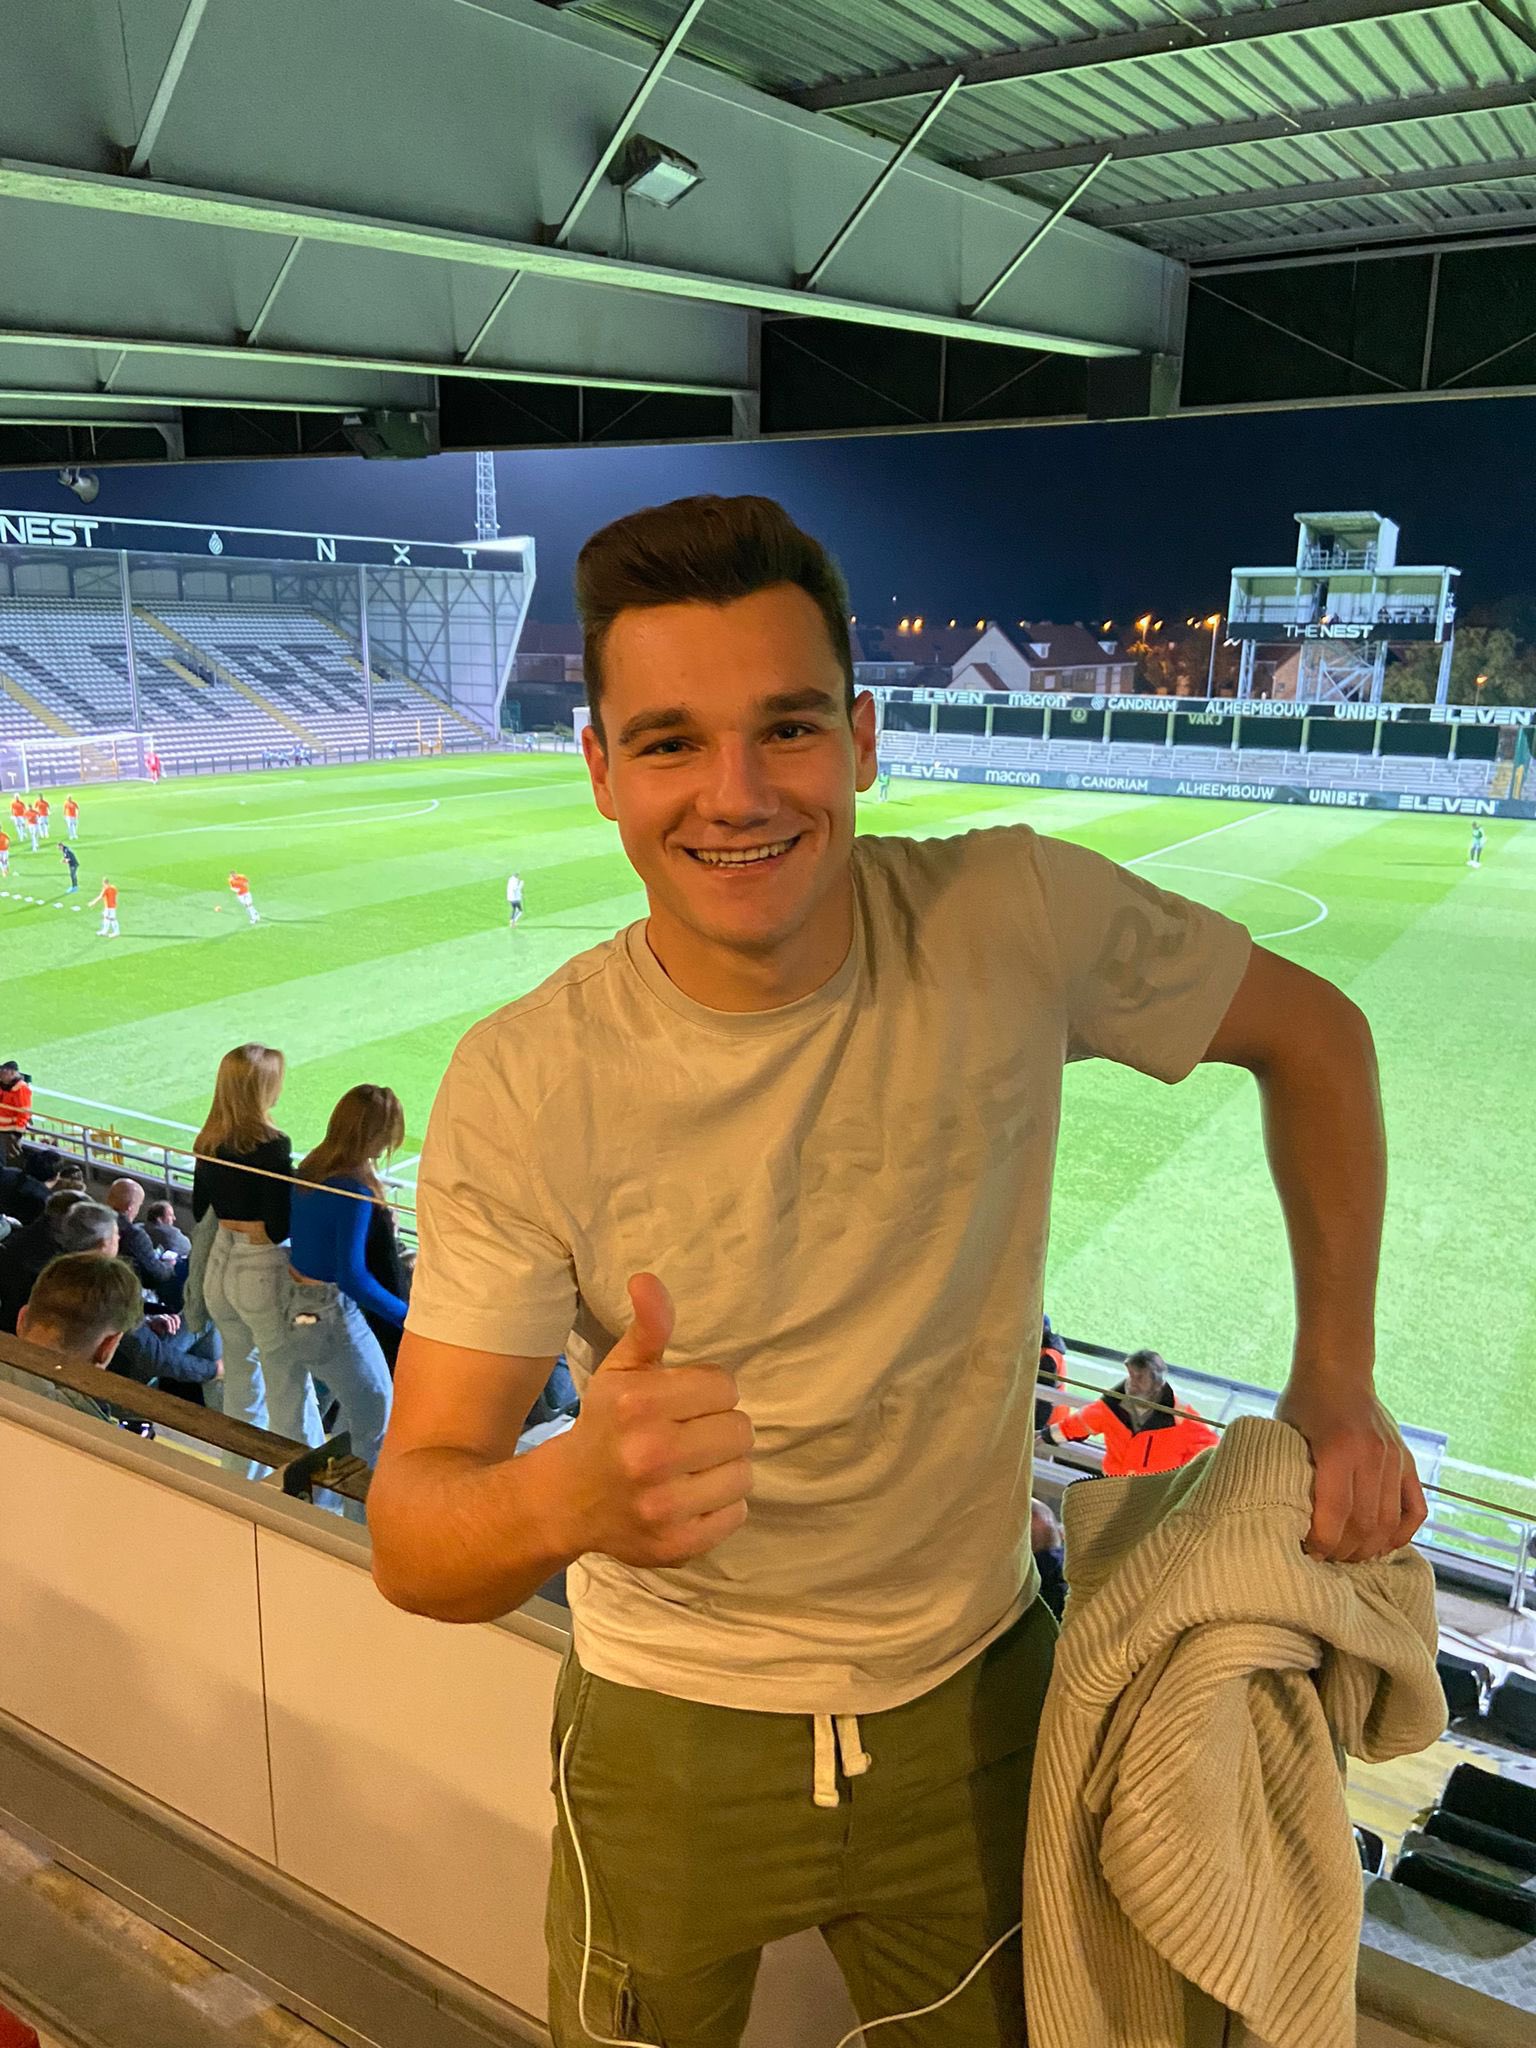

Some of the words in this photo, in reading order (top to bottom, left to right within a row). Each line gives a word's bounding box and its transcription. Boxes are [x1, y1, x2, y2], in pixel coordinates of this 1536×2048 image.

[0, 515, 99, 547] NEST
[1283, 624, 1318, 638] THE
[1320, 624, 1374, 639] NEST
[912, 689, 984, 704] ELEVEN
[1108, 697, 1178, 712] CANDRIAM
[1205, 700, 1309, 717] ALHEEMBOUW
[1334, 704, 1401, 721] UNIBET
[1429, 708, 1532, 726] ELEVEN
[890, 763, 959, 779] ELEVEN
[1081, 775, 1149, 791] CANDRIAM
[1176, 781, 1275, 800] ALHEEMBOUW
[1309, 789, 1369, 806] UNIBET
[1398, 794, 1496, 815] ELEVEN
